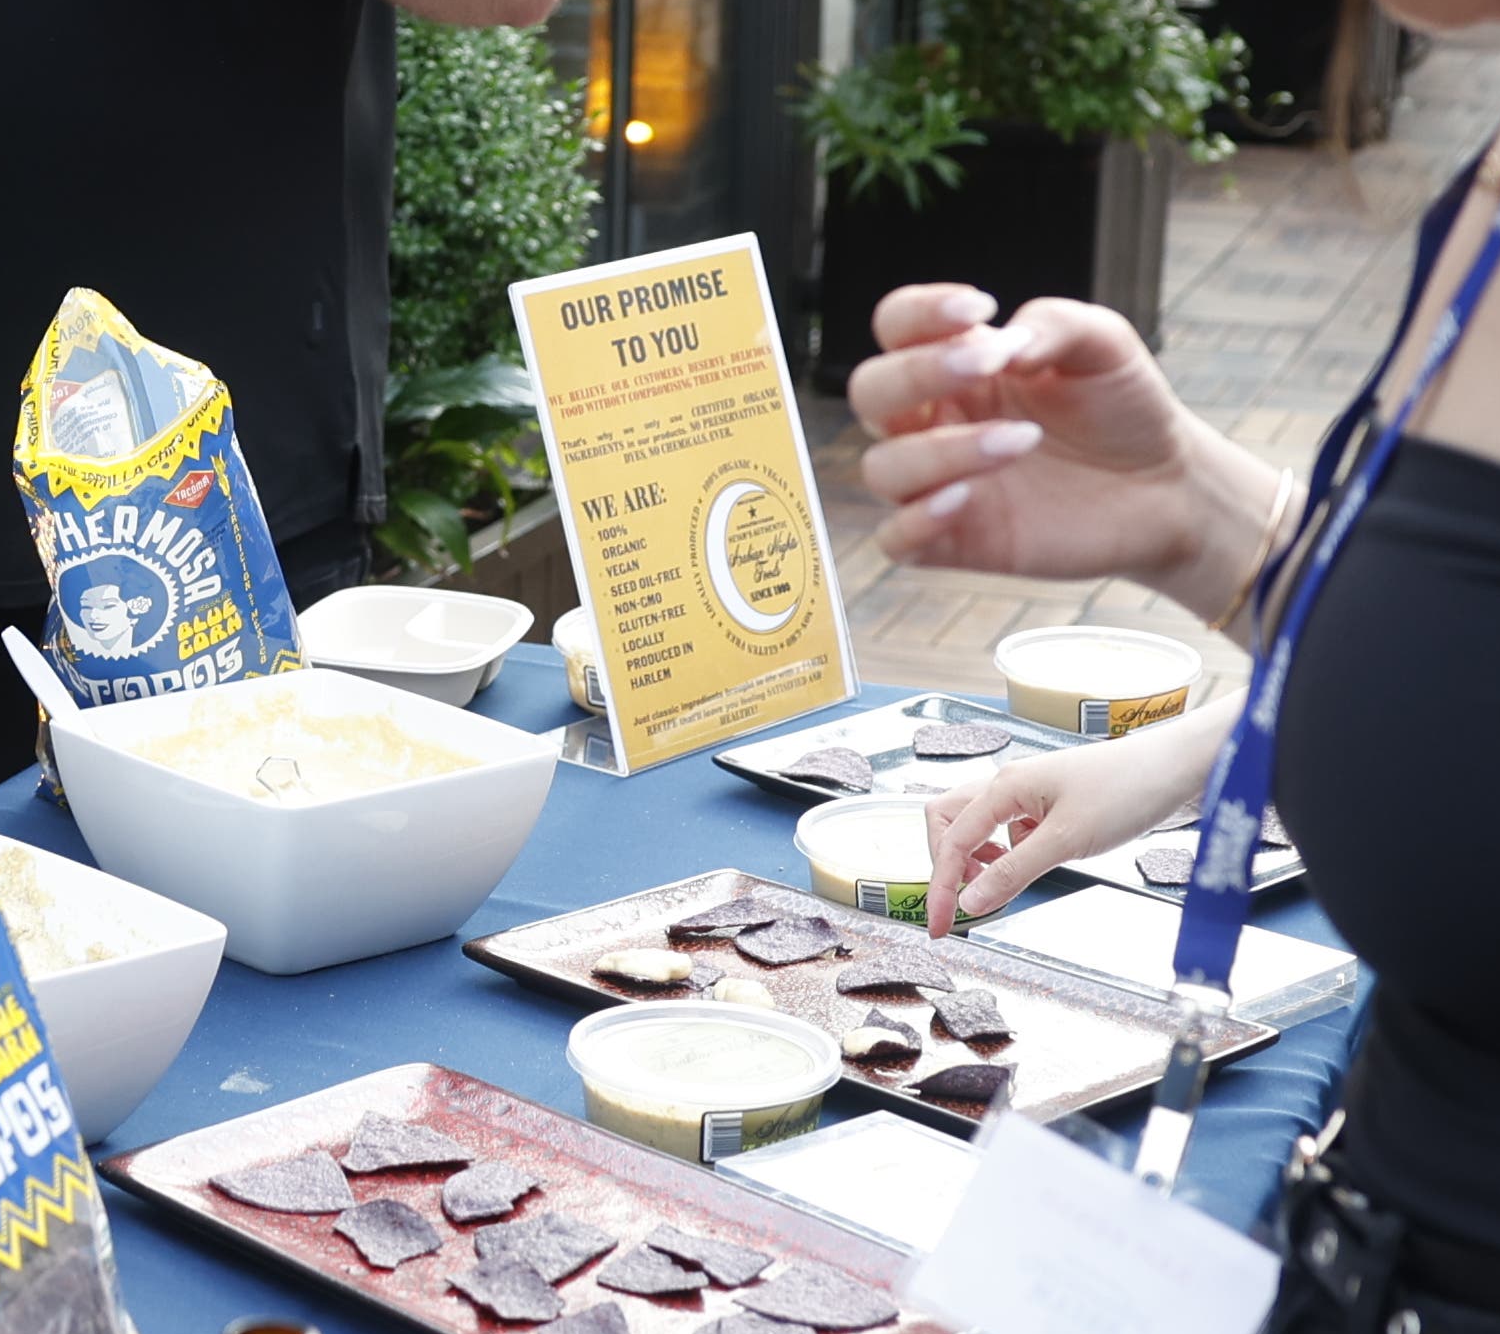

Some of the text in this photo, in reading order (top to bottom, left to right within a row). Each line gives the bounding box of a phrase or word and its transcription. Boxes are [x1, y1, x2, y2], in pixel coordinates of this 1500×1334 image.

[560, 269, 728, 331] OUR PROMISE
[611, 322, 700, 367] TO YOU
[548, 345, 773, 408] WE BELIEVE OUR CUSTOMERS DESERVE DELICIOUS
[560, 404, 585, 420] FOOD
[586, 394, 627, 414] WITHOUT
[628, 377, 693, 403] COMPROMISING
[693, 369, 722, 388] THEIR
[561, 436, 587, 451] That's
[597, 431, 614, 443] why
[623, 426, 635, 436] we
[644, 419, 661, 430] only
[691, 397, 736, 418] CERTIFIED
[743, 387, 779, 406] ORGANIC
[565, 440, 625, 465] INGREDIENTS
[626, 439, 636, 449] in
[637, 436, 650, 447] our
[690, 419, 702, 432] NO
[770, 400, 783, 413] NO
[648, 445, 661, 457] NO
[717, 459, 751, 477] ORGANIC
[763, 464, 789, 492] VEGAN
[581, 481, 668, 524] WE ARE:
[597, 524, 628, 542] 100%
[602, 537, 648, 560] ORGANIC
[688, 505, 702, 569] PRODUCED
[52, 505, 222, 611] HERMOSA
[605, 558, 640, 578] VEGAN
[610, 567, 683, 597] SEED OIL-FREE
[750, 586, 774, 603] SINCE
[614, 592, 663, 616] NON-GMO
[618, 604, 687, 634] GLUTEN-FREE
[177, 598, 238, 642] BLUE
[179, 611, 243, 661] CORN
[622, 630, 667, 654] LOCALLY
[626, 641, 694, 672] PRODUCED IN
[630, 667, 672, 690] HARLEM
[633, 714, 651, 727] Just
[651, 706, 680, 721] classic
[681, 690, 723, 713] ingredients
[646, 718, 678, 737] RECIPE
[702, 706, 724, 720] leave
[725, 700, 739, 713] you
[808, 670, 823, 684] AND
[1111, 697, 1181, 723] Arabian
